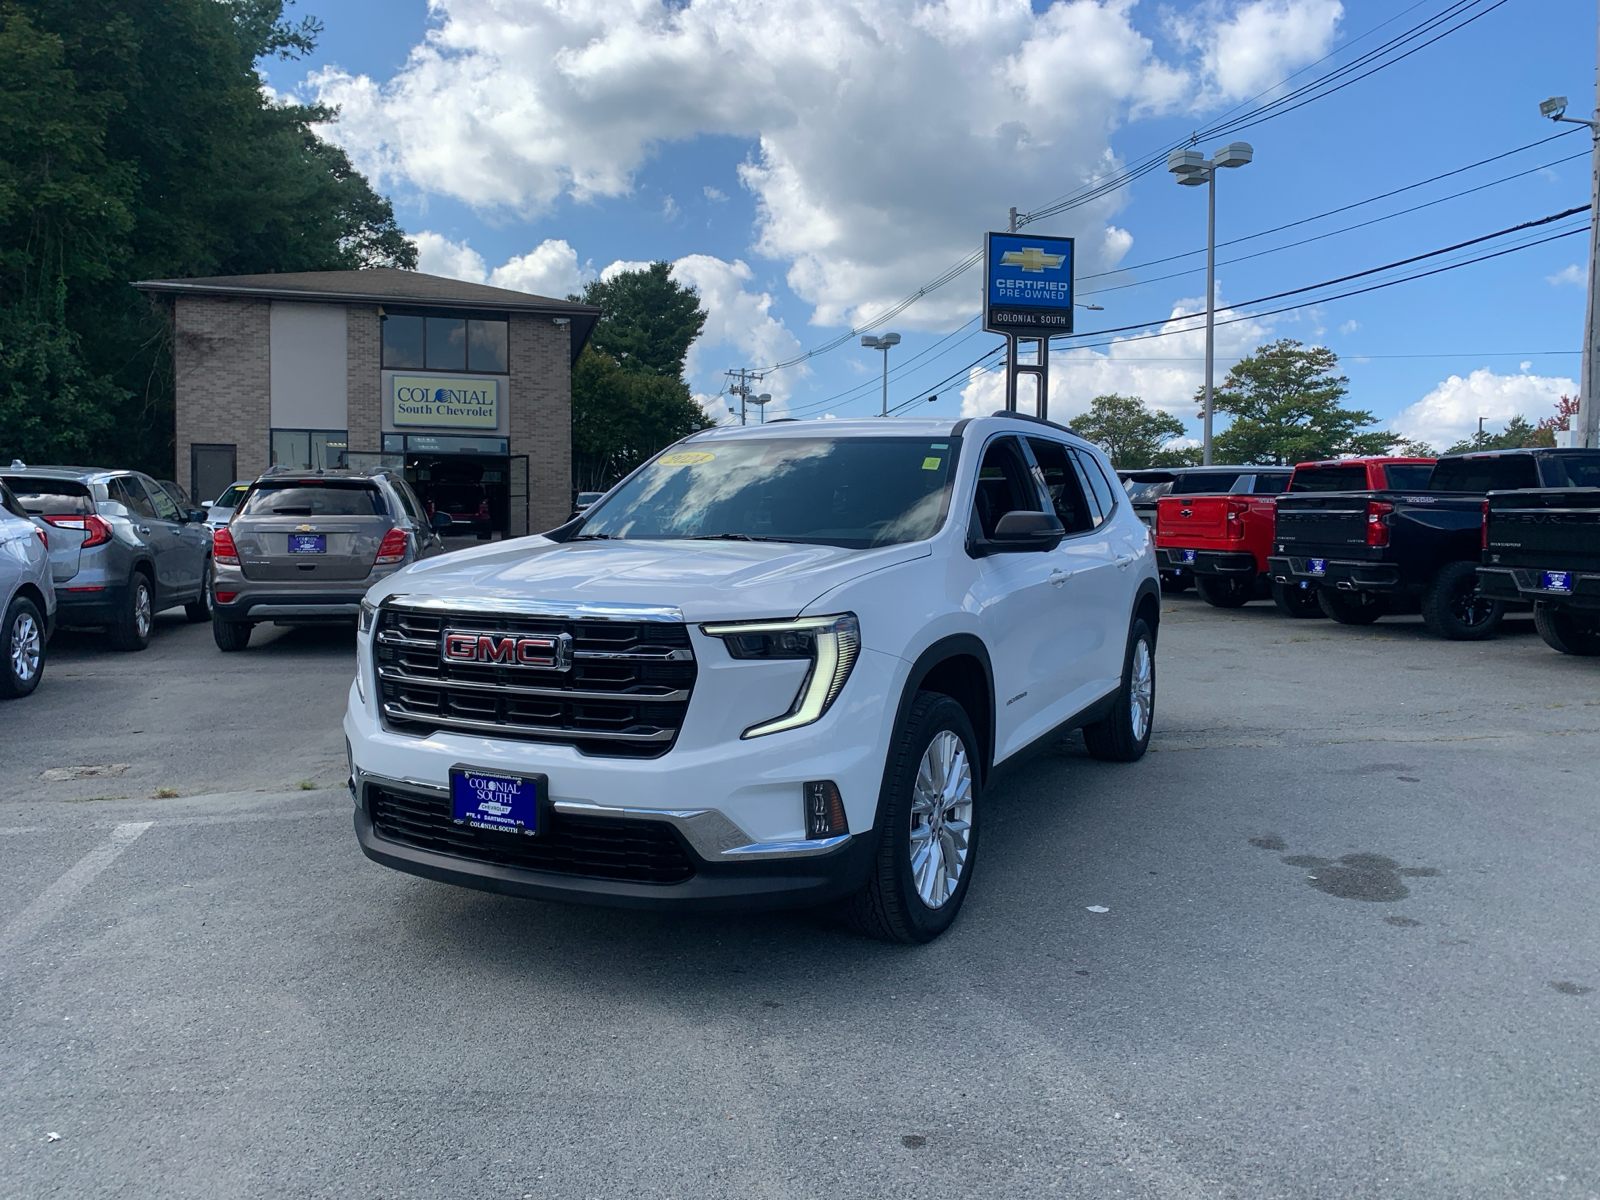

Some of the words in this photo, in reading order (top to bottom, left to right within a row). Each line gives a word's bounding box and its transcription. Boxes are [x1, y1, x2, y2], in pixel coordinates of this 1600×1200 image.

[996, 279, 1068, 291] CERTIFIED
[999, 289, 1064, 299] PRE-OWNED
[997, 313, 1036, 323] COLONIAL
[1040, 315, 1066, 324] SOUTH
[397, 387, 494, 405] COLONIAL
[398, 403, 432, 415] South
[436, 405, 493, 417] Chevrolet
[446, 634, 555, 666] GMC
[469, 778, 521, 794] COLONIAL
[477, 789, 512, 803] SOUTH
[481, 804, 509, 813] CHEVROLET
[470, 821, 498, 830] COLONIAL
